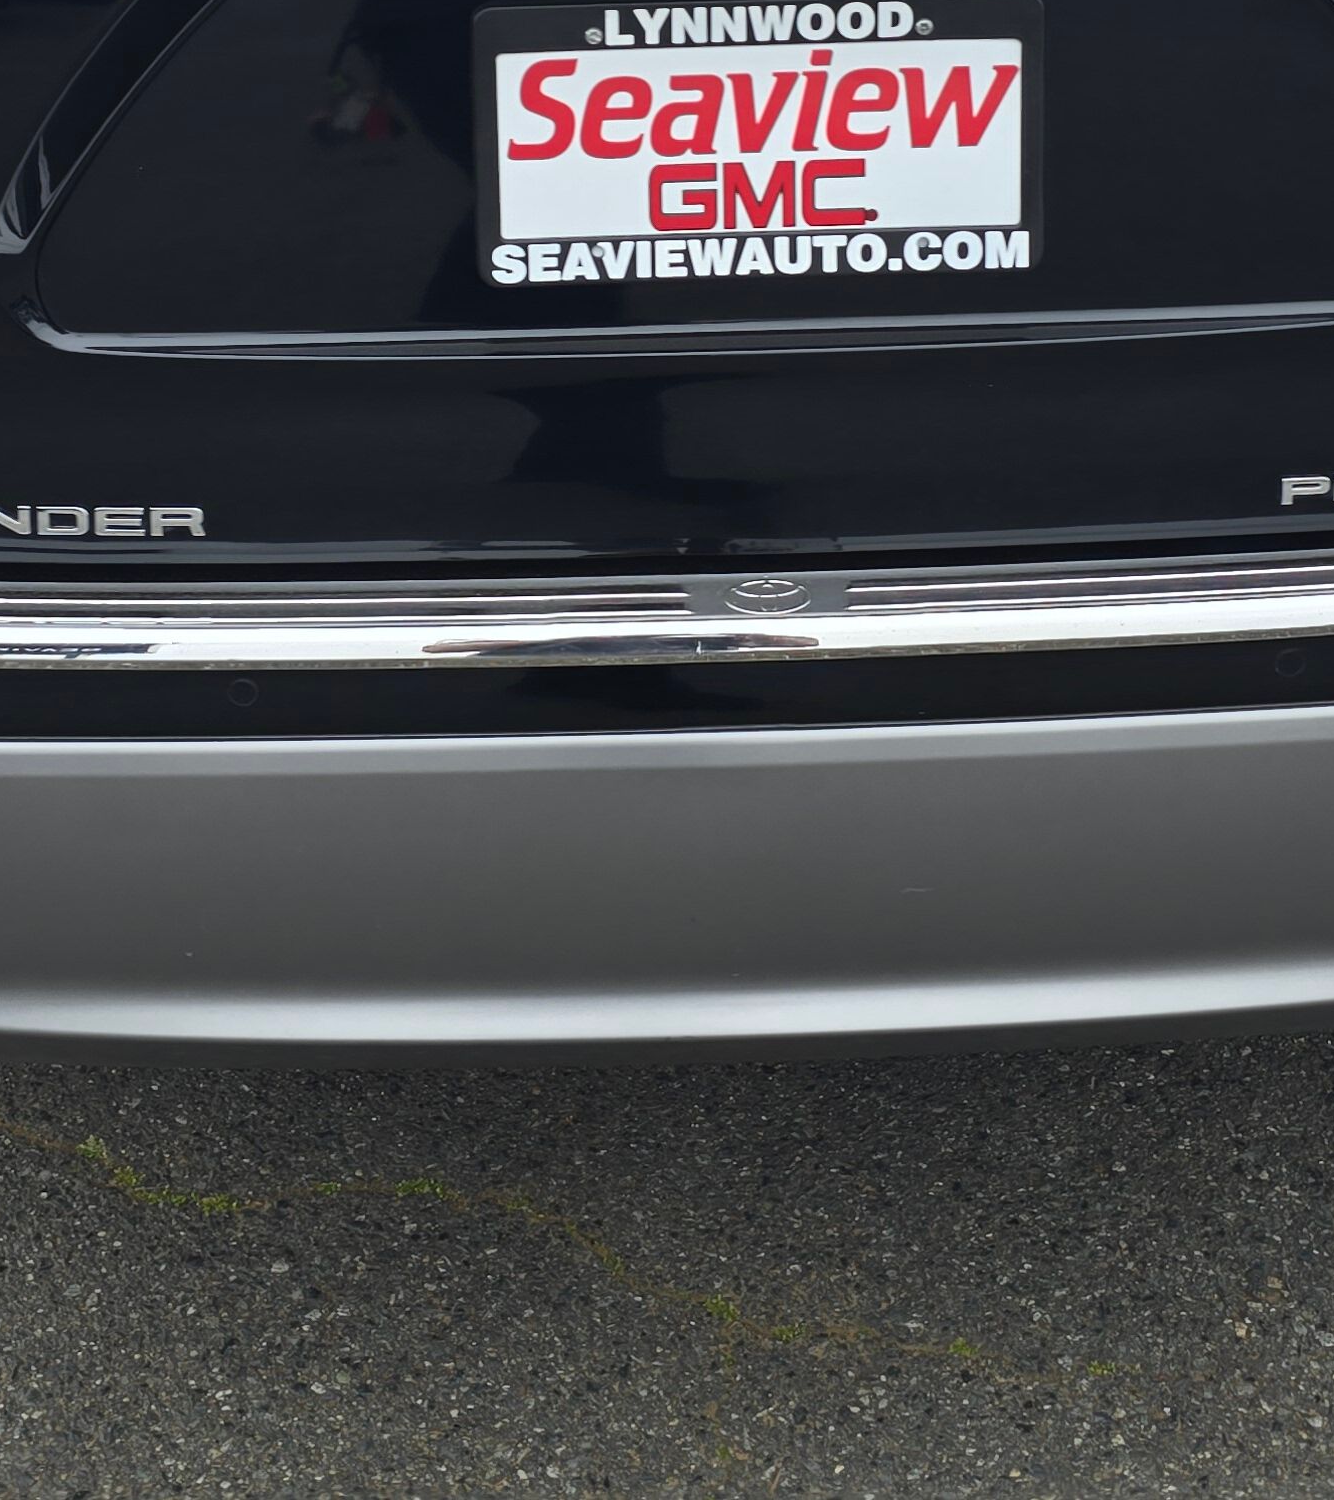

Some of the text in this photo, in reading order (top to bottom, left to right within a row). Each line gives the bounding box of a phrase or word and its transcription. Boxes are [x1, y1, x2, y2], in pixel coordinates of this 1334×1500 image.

[603, 1, 914, 47] LYNNWOOD
[507, 49, 1020, 161] Seaview
[648, 158, 867, 232] GMC
[491, 231, 1031, 285] SEAVIEWAUTO.COM
